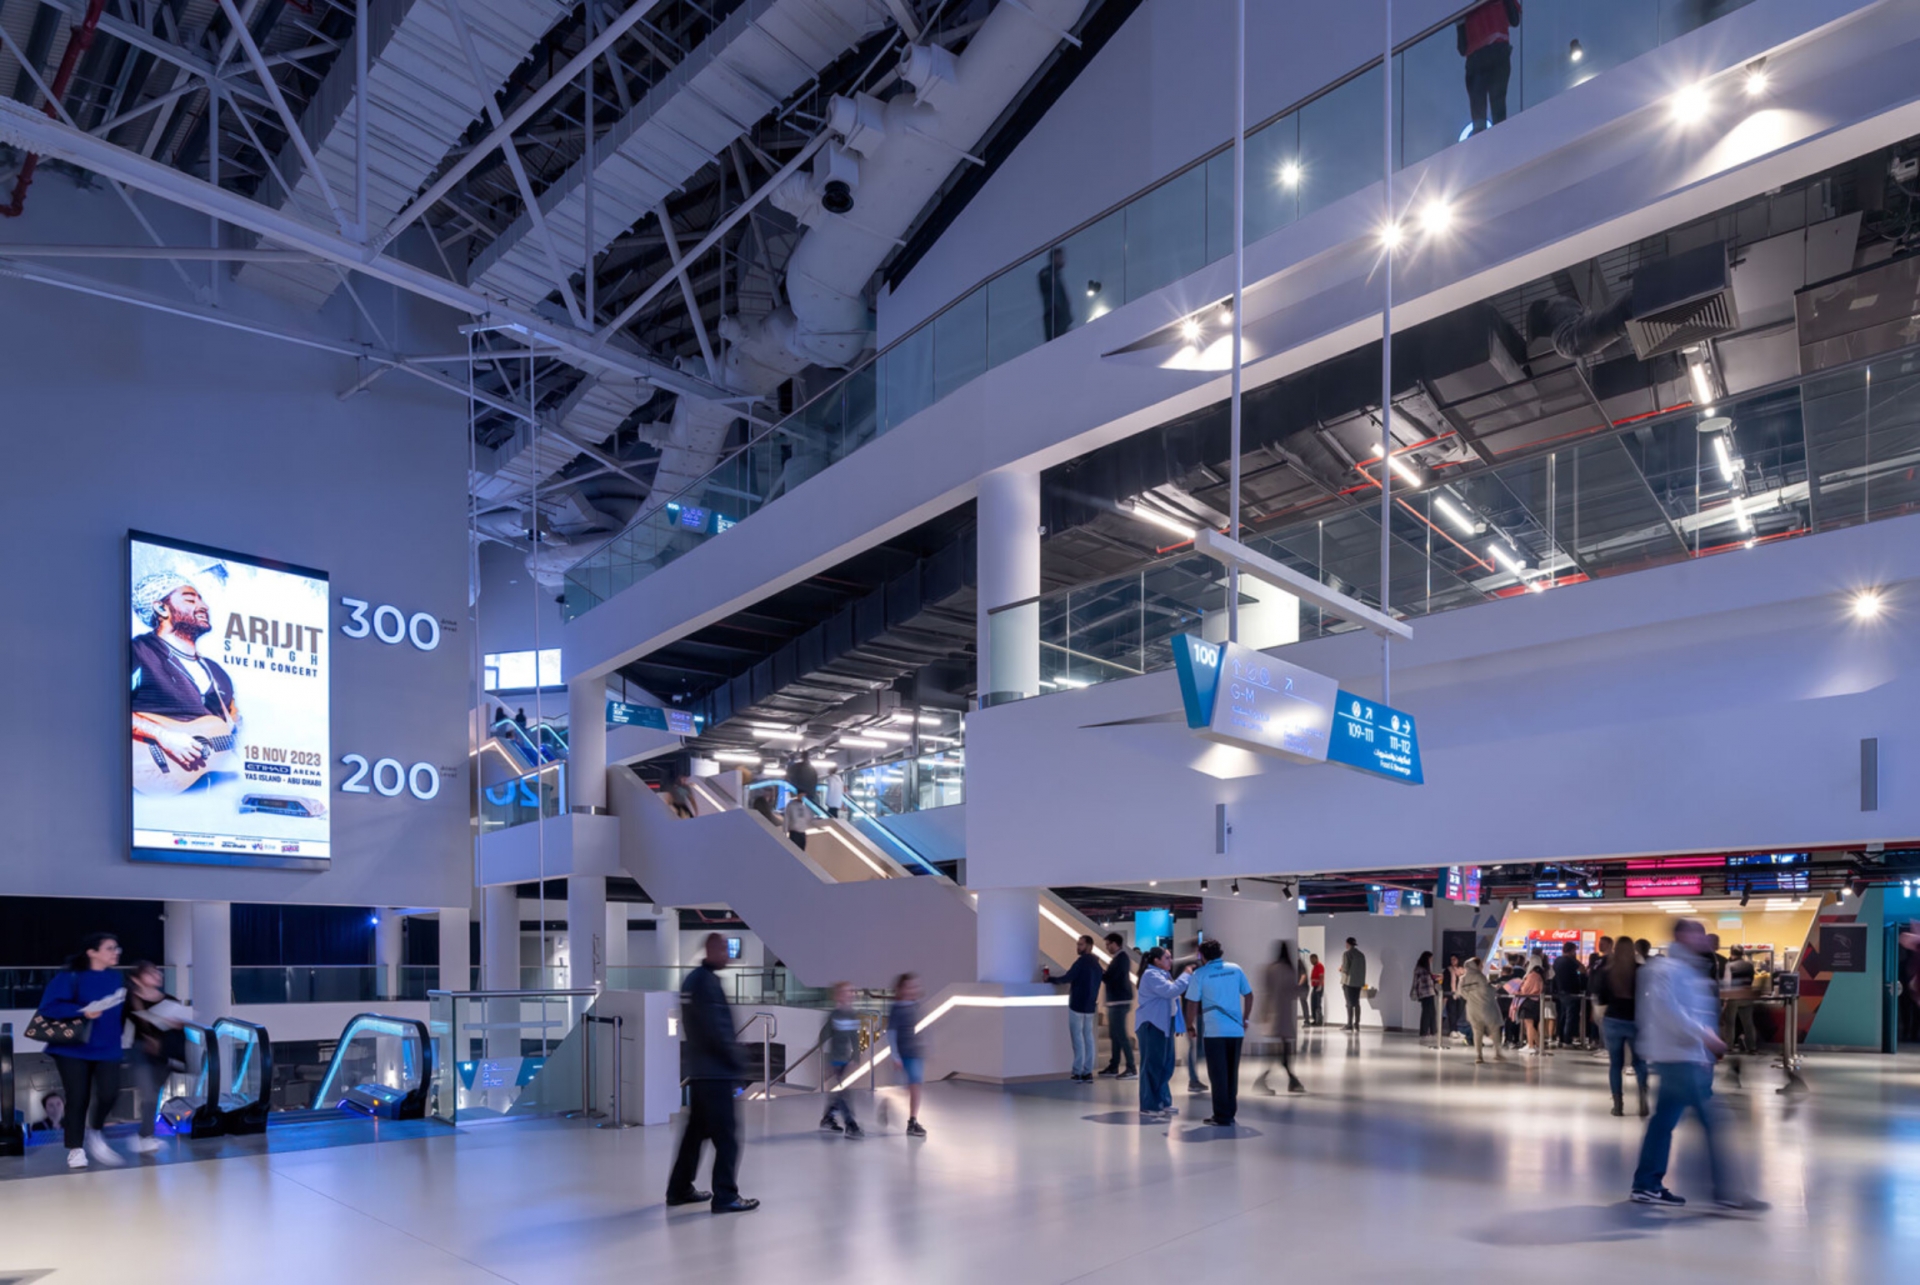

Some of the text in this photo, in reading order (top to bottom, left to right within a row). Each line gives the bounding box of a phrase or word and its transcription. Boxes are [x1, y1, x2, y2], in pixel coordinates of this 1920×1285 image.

[224, 612, 323, 654] ARIJIT
[341, 596, 440, 651] 300
[224, 639, 318, 665] SINGH
[1193, 643, 1217, 668] 100
[223, 654, 318, 678] LIVE IN CONCERT
[1230, 683, 1255, 704] G-M
[1347, 721, 1374, 743] 109-111
[244, 744, 322, 767] 18 NOV 2023
[245, 772, 257, 781] YAS
[258, 774, 282, 784] ISLAND
[247, 764, 321, 777] ETIHAD ARENA
[341, 753, 440, 800] 200
